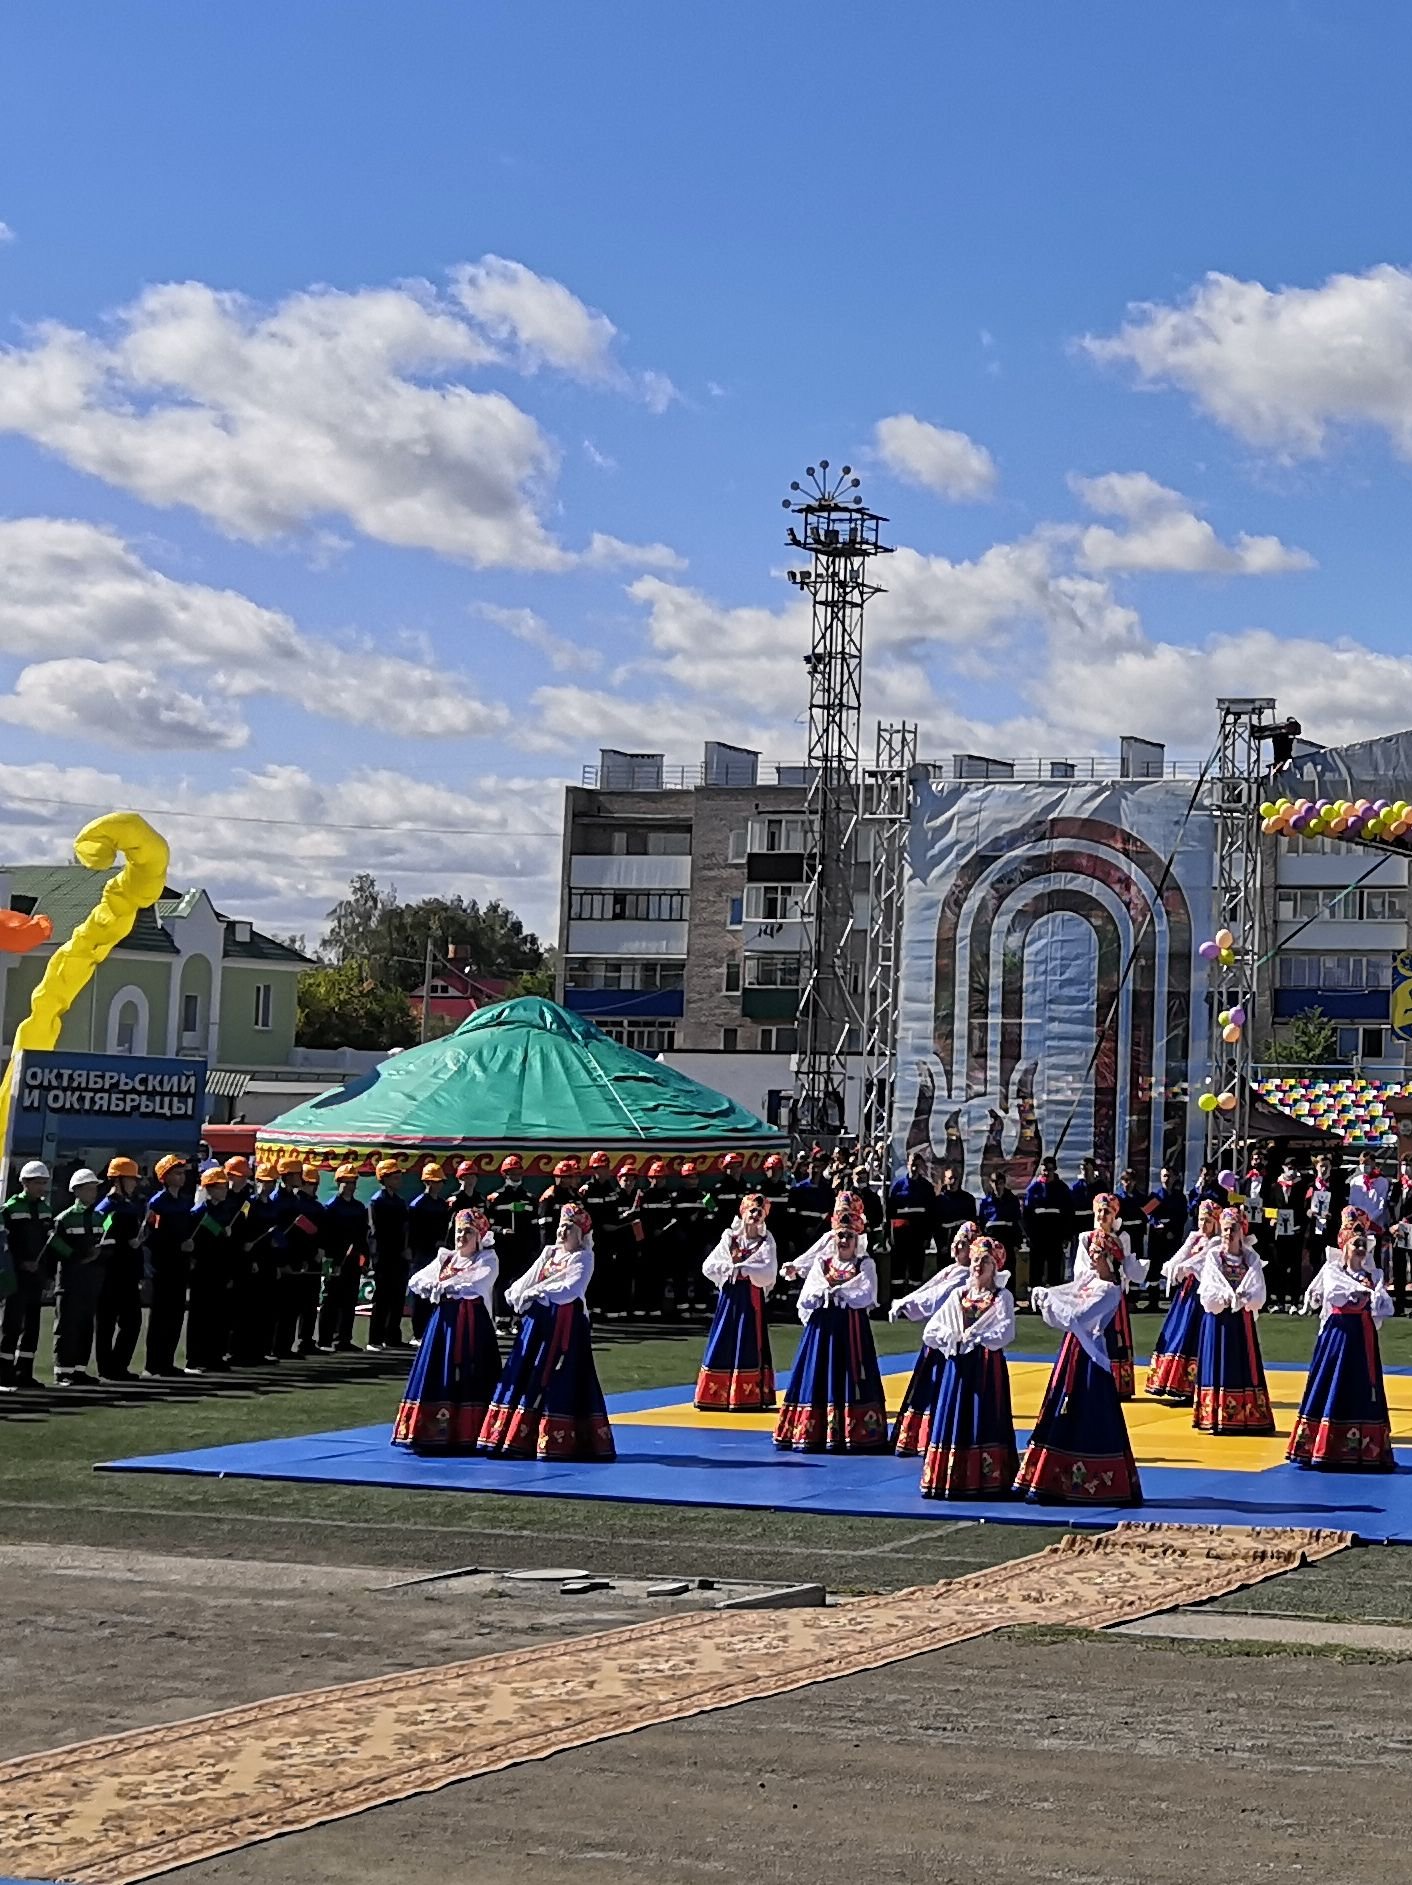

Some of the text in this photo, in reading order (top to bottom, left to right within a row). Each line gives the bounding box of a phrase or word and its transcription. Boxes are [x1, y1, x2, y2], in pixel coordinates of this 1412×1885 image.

[25, 1067, 196, 1094] ОКТЯБРЬСКИЙ
[23, 1088, 193, 1116] И ОКТЯБРЬЦЫ
